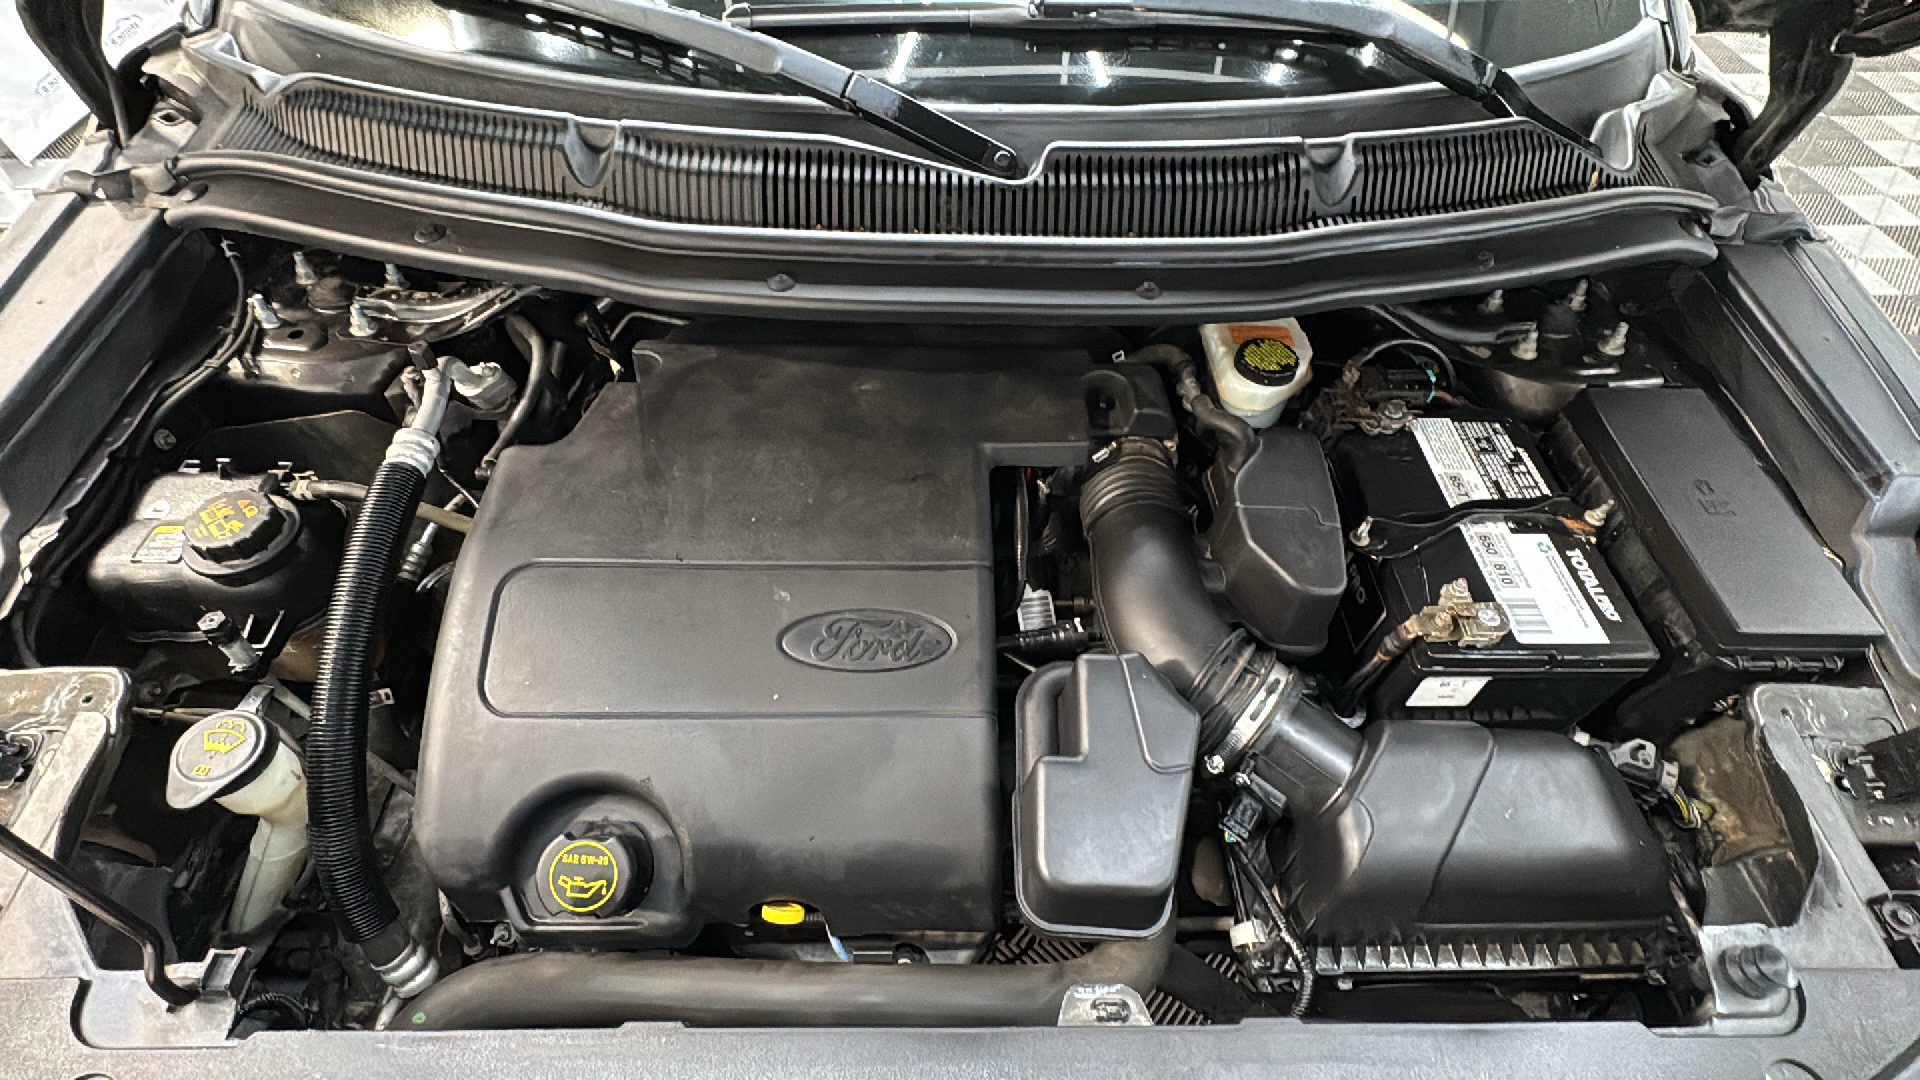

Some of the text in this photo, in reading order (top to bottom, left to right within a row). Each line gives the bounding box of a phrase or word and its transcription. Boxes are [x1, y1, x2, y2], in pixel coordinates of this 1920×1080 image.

[1478, 535, 1499, 555] 650
[1493, 563, 1514, 585] 810
[1565, 547, 1623, 623] TOTALPRO
[810, 616, 925, 662] Ford
[561, 853, 578, 864] SAE
